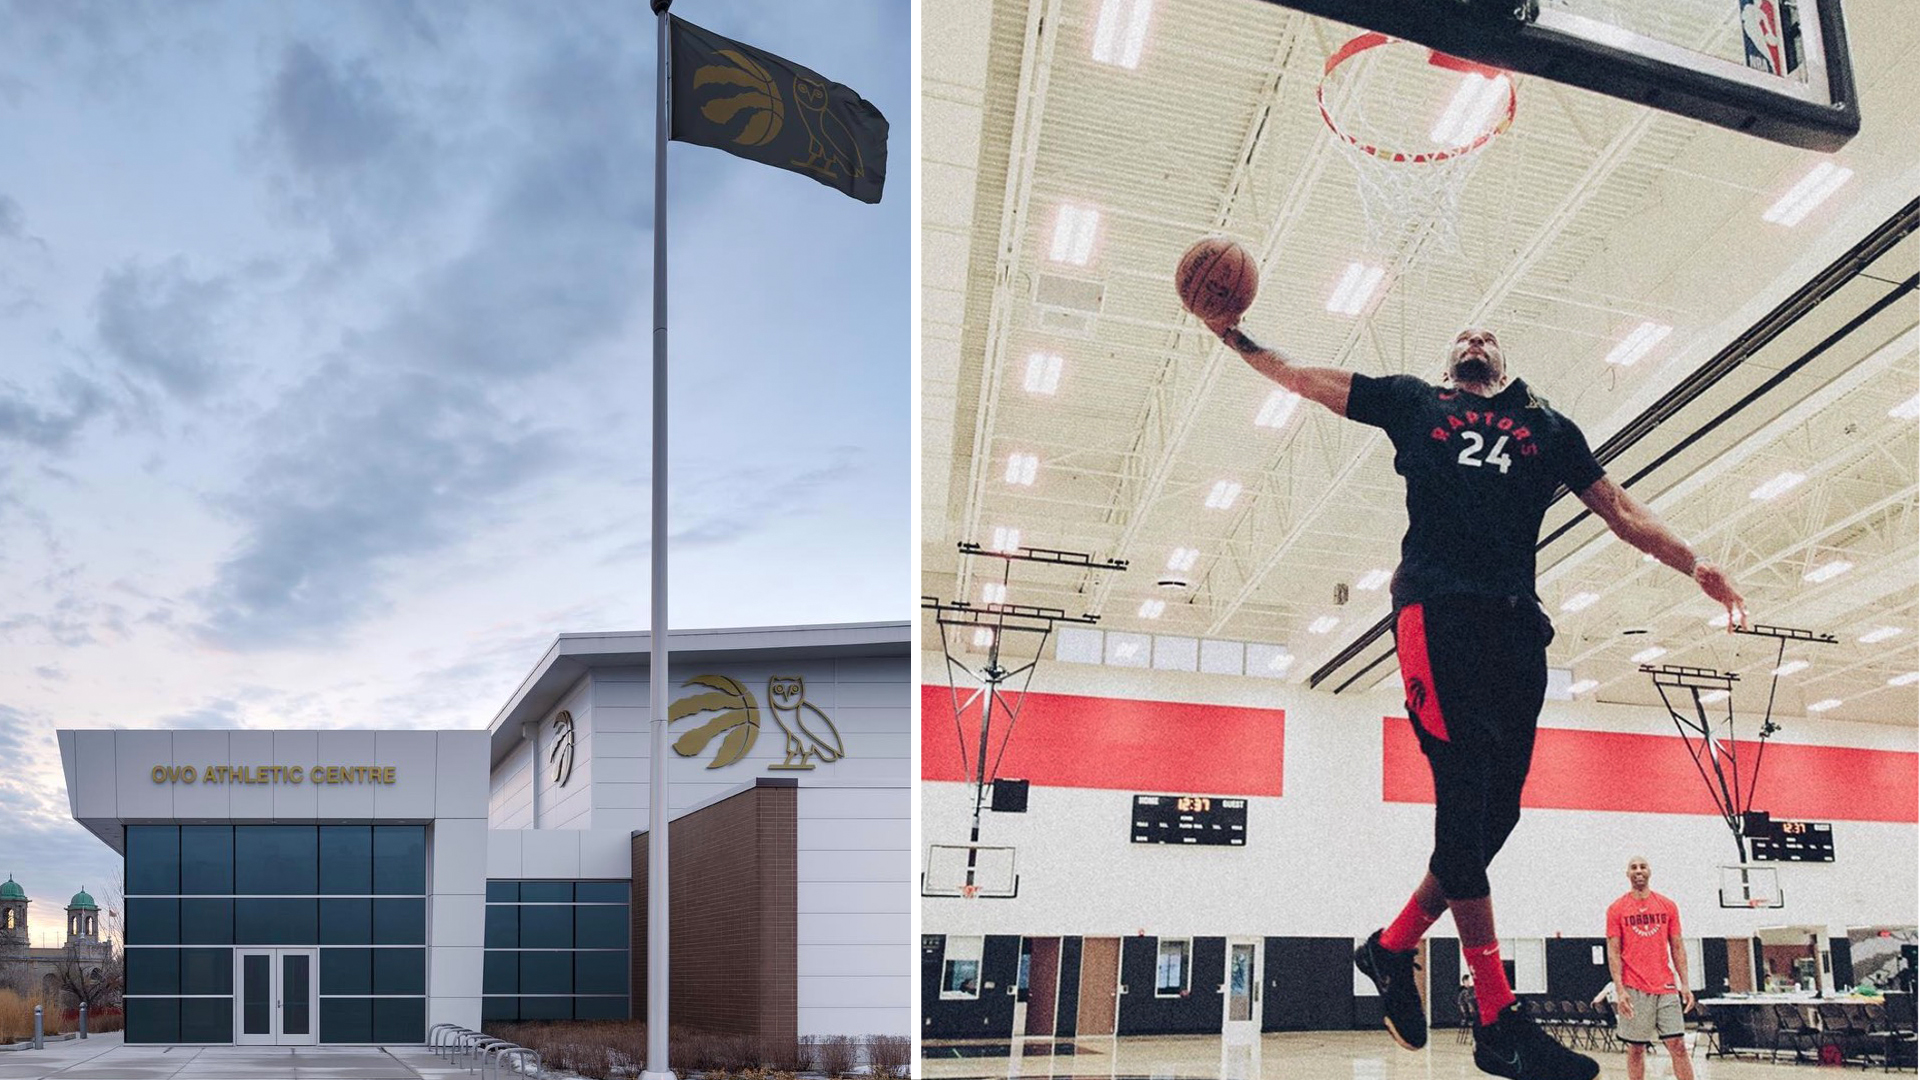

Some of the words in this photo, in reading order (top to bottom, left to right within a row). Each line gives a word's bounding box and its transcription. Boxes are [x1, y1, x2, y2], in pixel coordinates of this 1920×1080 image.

[1430, 410, 1538, 457] RAPTORS
[1457, 430, 1512, 475] 24
[151, 765, 197, 784] OVO
[202, 765, 304, 784] ATHLETIC
[309, 765, 397, 784] CENTRE
[1177, 797, 1211, 812] 12:37
[1623, 912, 1668, 927] TORONTO
